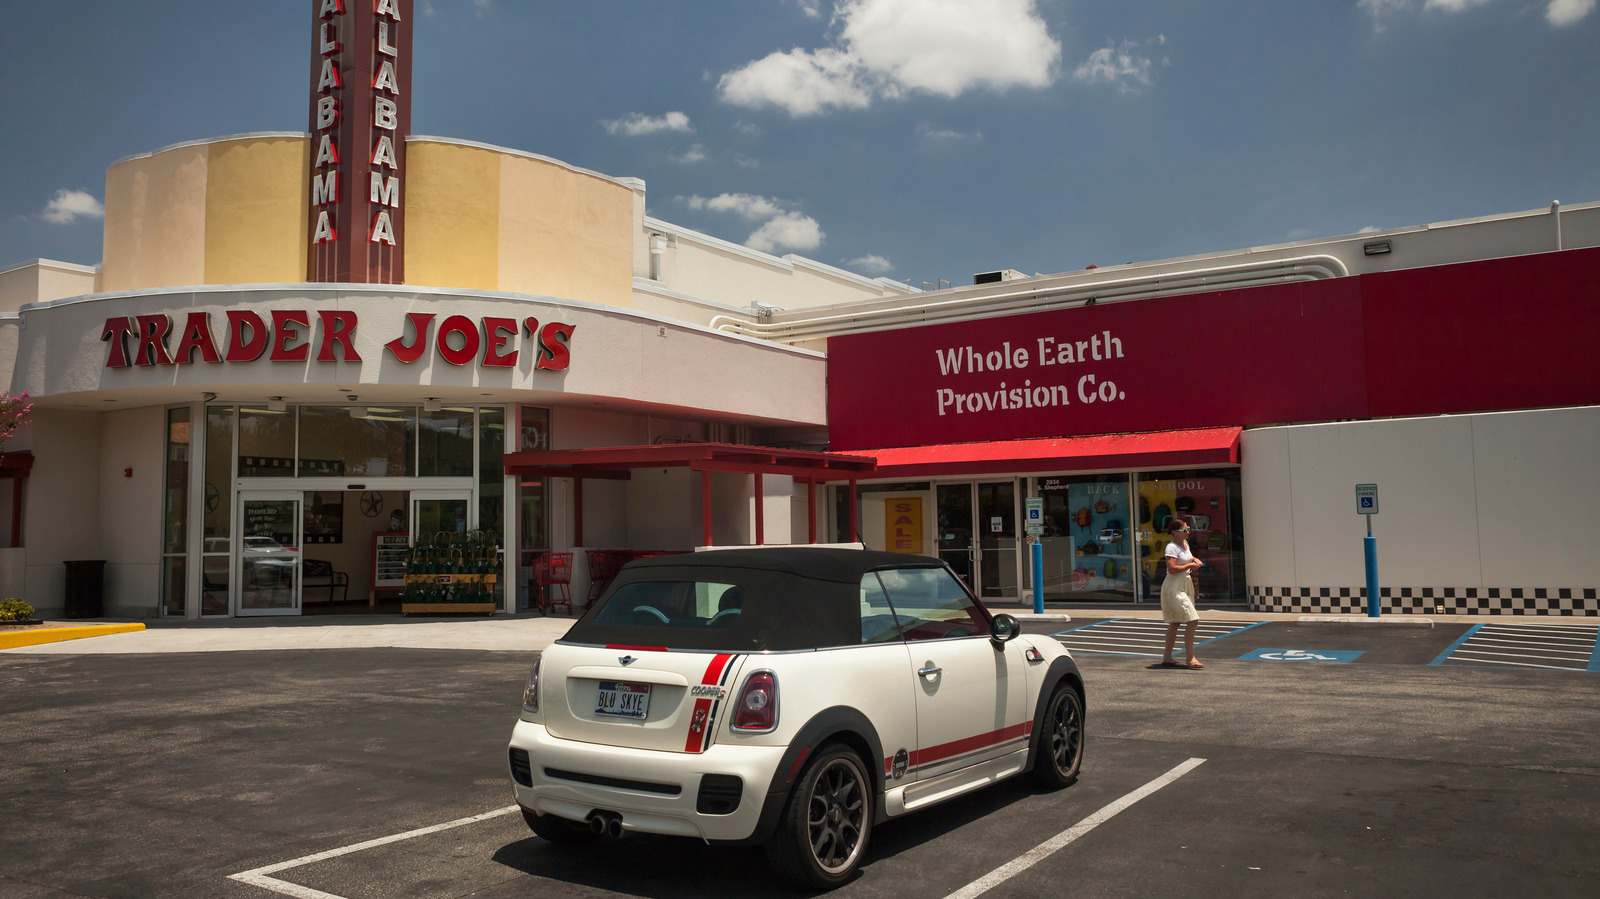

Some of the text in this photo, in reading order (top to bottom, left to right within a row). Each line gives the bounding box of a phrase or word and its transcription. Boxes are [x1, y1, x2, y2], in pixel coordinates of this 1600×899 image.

[101, 310, 577, 372] TRADER JOE'S
[936, 330, 1125, 376] Whole Earth
[936, 374, 1126, 416] Provision Co.
[1087, 485, 1120, 495] BACK
[1151, 481, 1205, 491] SCHOOL
[894, 503, 914, 550] SALE
[598, 691, 644, 711] BLU SKYE
